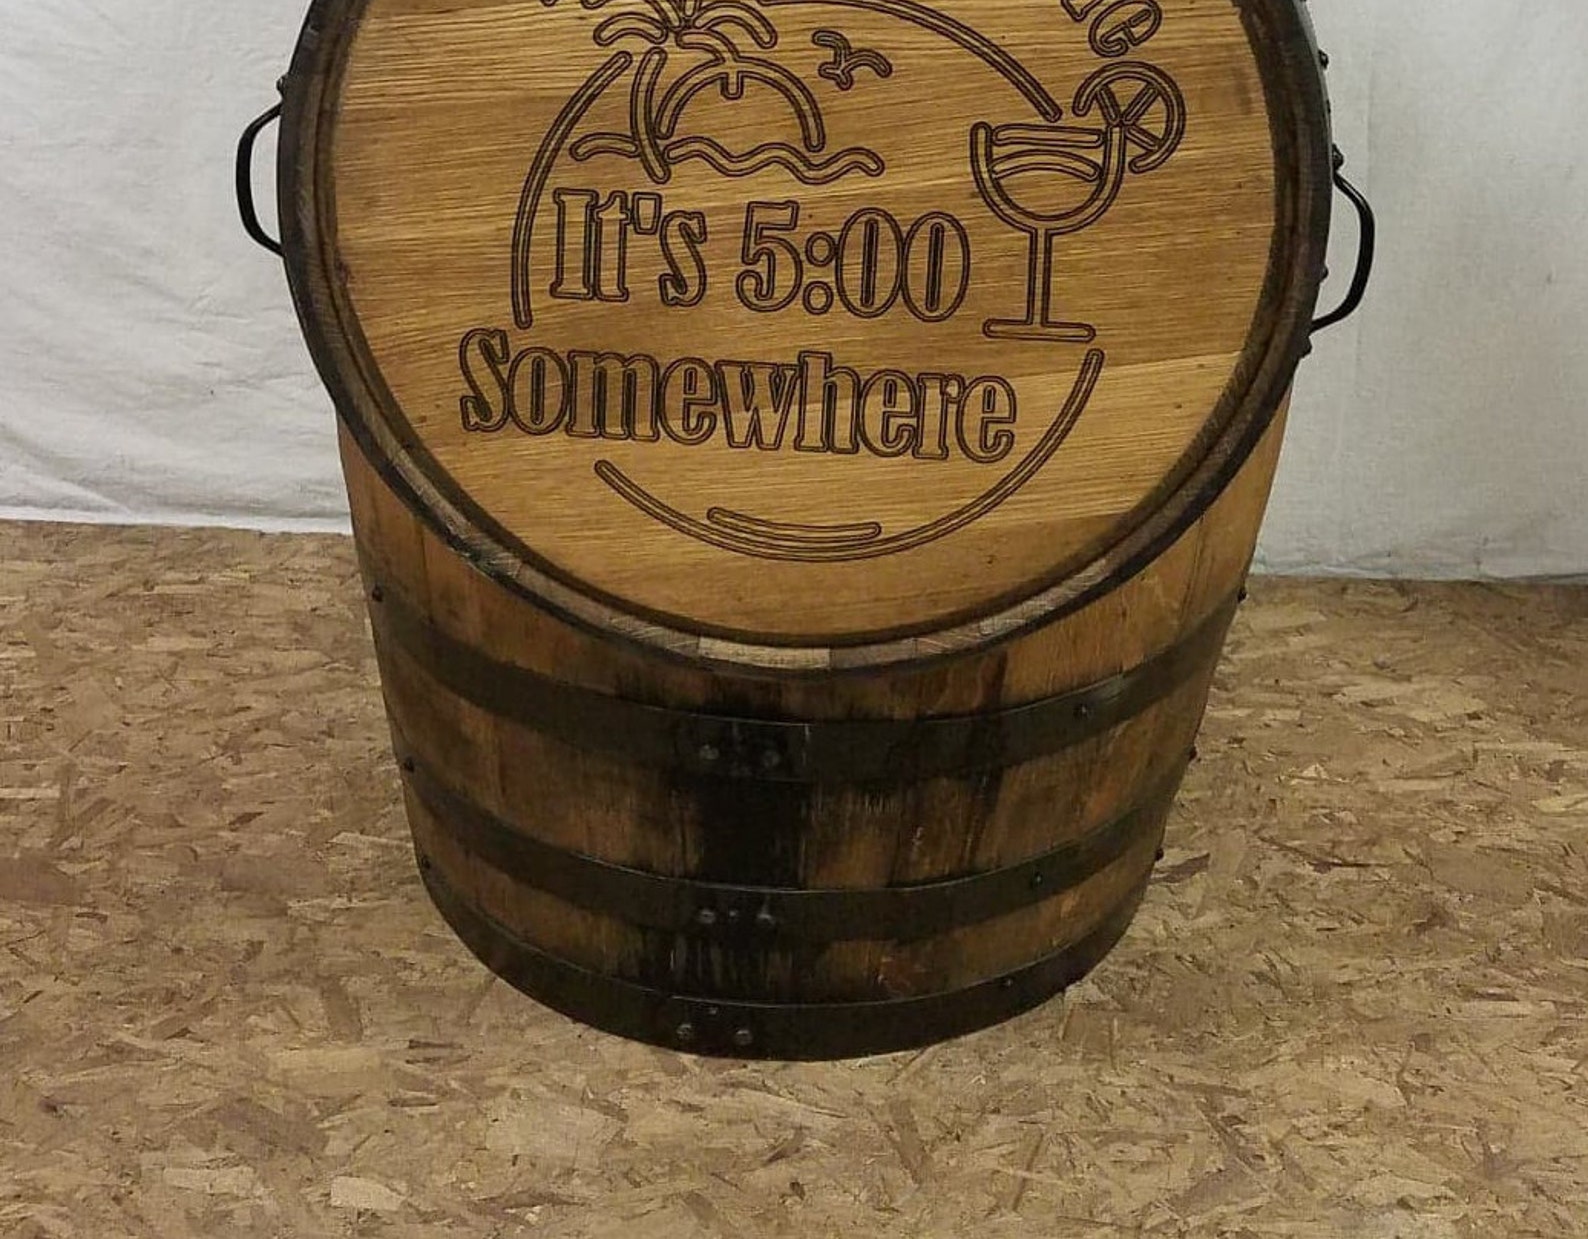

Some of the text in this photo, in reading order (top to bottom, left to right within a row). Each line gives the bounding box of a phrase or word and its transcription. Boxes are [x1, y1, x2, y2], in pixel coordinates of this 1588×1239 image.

[551, 188, 971, 322] It's 5:00
[459, 328, 1017, 463] Somewhere
